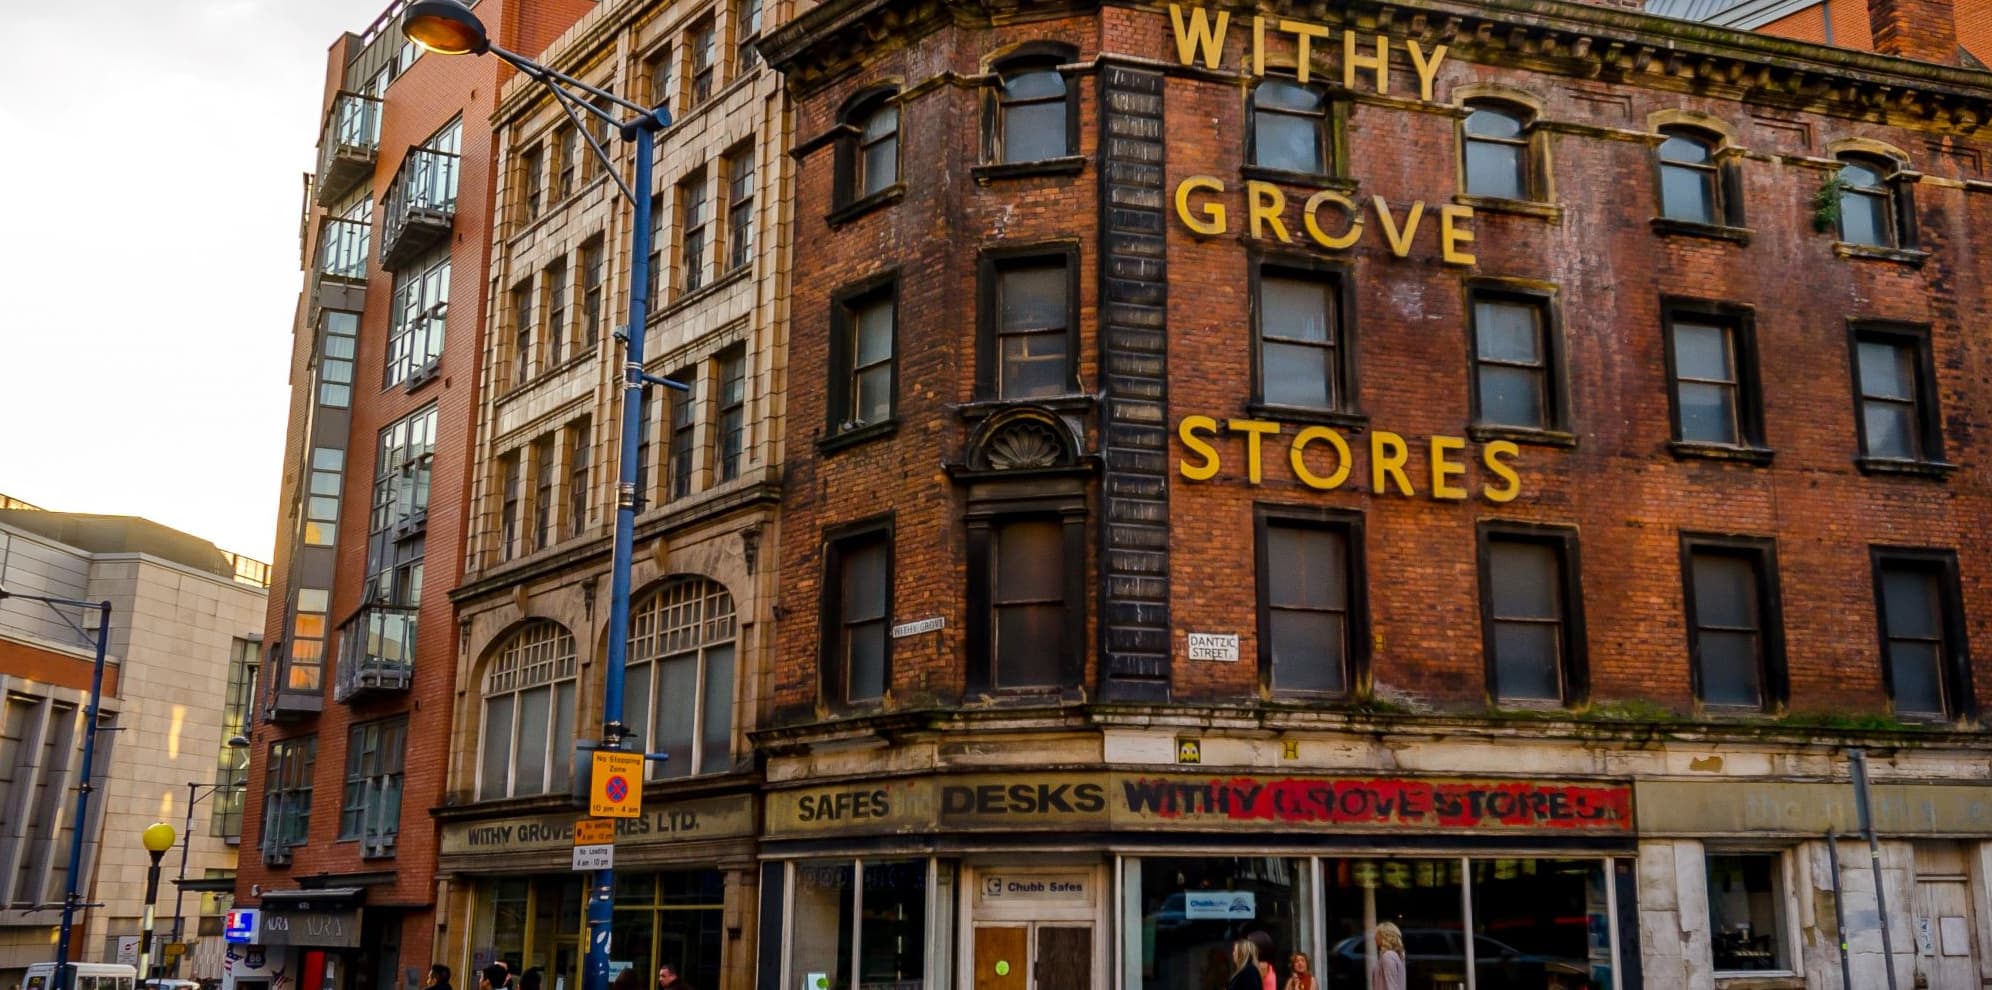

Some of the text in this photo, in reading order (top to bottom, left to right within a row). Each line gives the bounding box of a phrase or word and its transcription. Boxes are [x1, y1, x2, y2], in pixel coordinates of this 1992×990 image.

[1169, 3, 1449, 101] WITHY
[1175, 175, 1477, 266] GROVE
[1178, 414, 1522, 503] STORES
[1190, 635, 1236, 648] DANTZIC
[592, 804, 602, 812] 10
[603, 805, 615, 814] pm
[628, 806, 639, 814] am
[797, 783, 1106, 822] SAFES DESKS
[1122, 780, 1263, 814] WITHY
[468, 825, 513, 846] WITHY
[517, 823, 574, 842] GROVE
[615, 817, 650, 836] RES
[1008, 881, 1046, 892] Chubb
[1049, 881, 1083, 892] Safes
